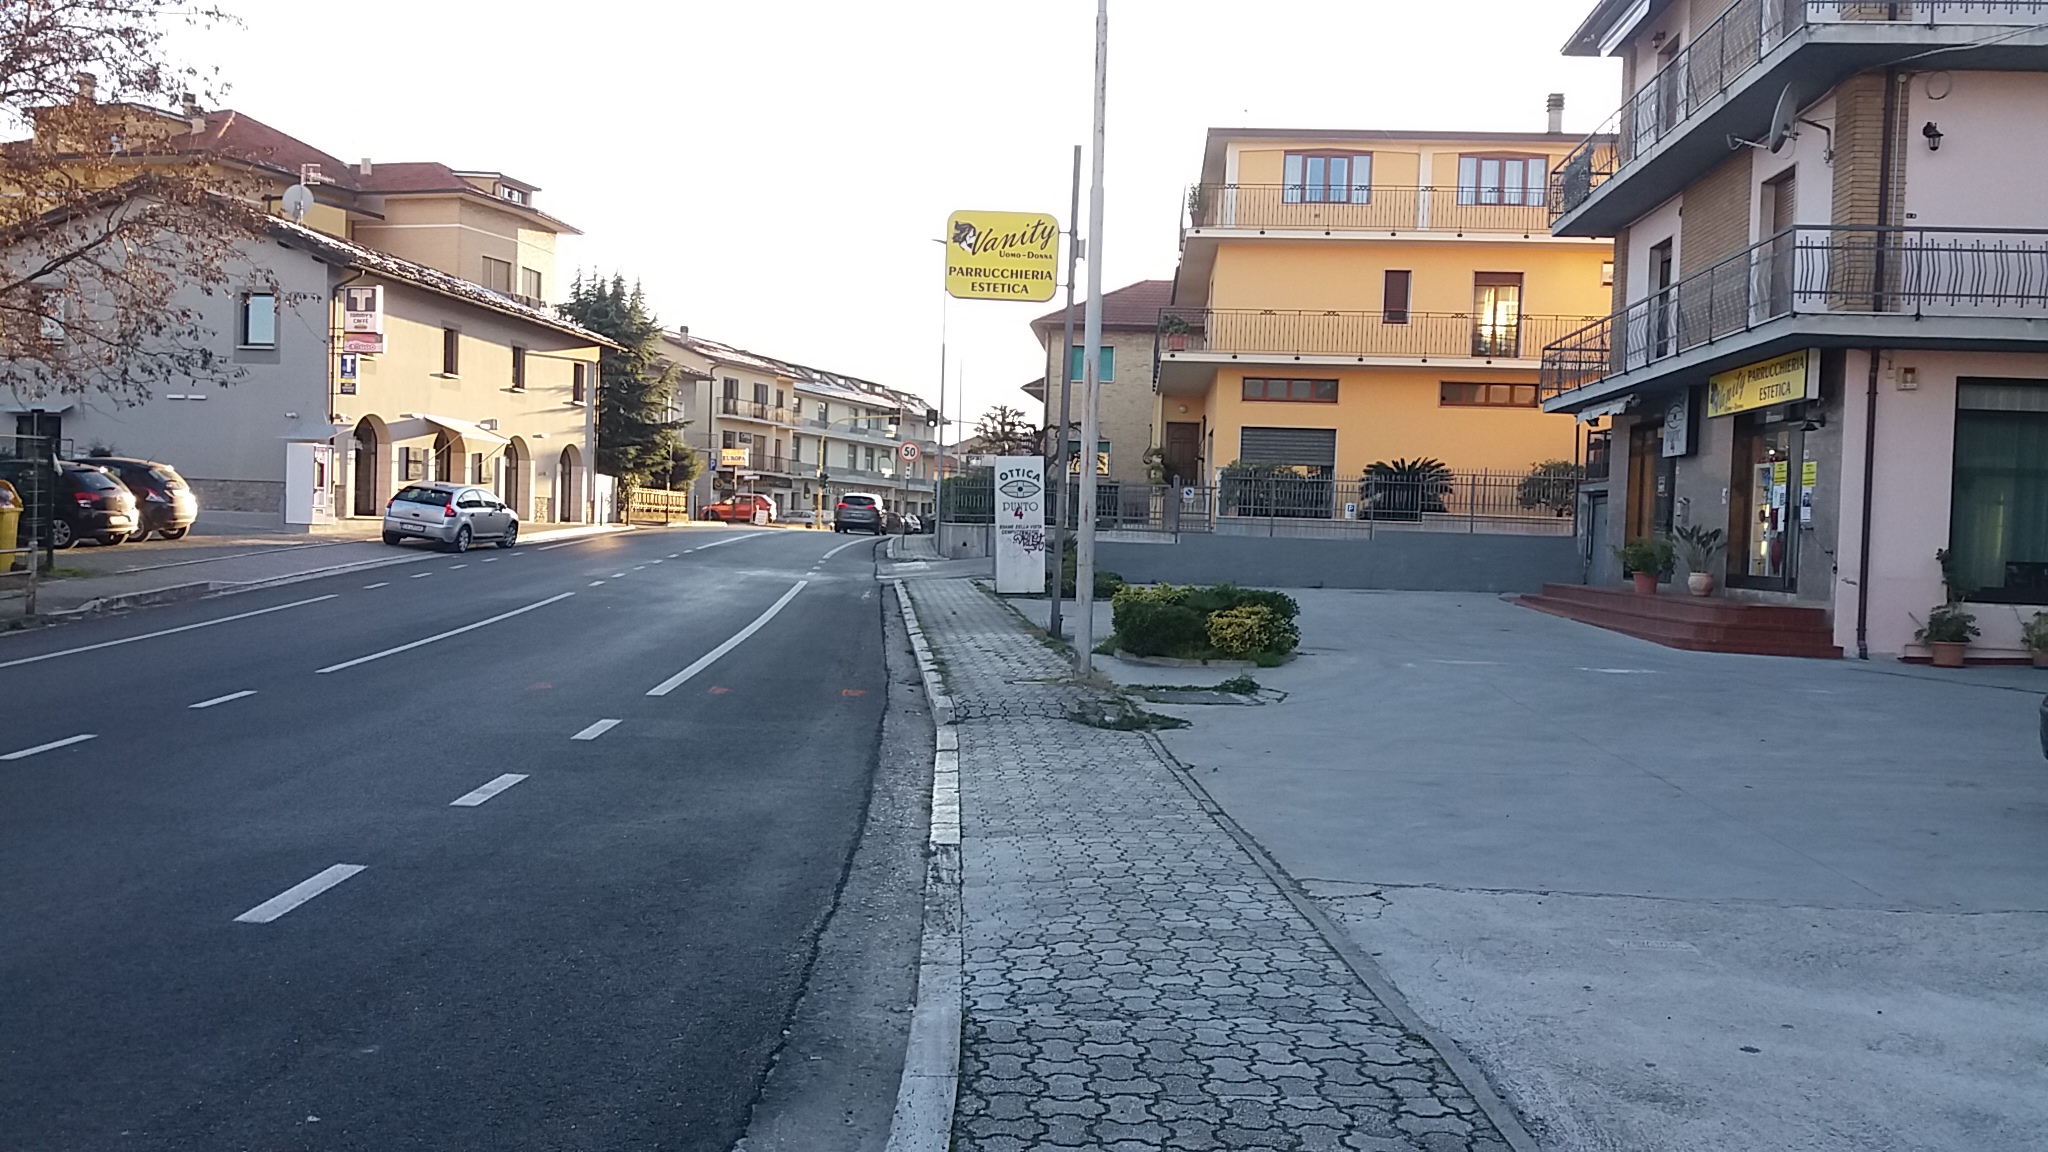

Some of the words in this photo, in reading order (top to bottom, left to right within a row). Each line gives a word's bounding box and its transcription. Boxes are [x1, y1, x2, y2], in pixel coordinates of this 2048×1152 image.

[972, 219, 1055, 256] Vanity
[948, 266, 1053, 281] PARRUCCHIERIA
[970, 282, 1029, 294] ESTETICA
[350, 289, 373, 311] T
[1747, 356, 1804, 384] PARRUCCHIERIA
[1759, 381, 1791, 401] ESTETICA
[903, 446, 916, 457] 50
[999, 468, 1041, 482] OTTICA
[1002, 501, 1039, 511] PUNTO
[1013, 506, 1024, 520] 4
